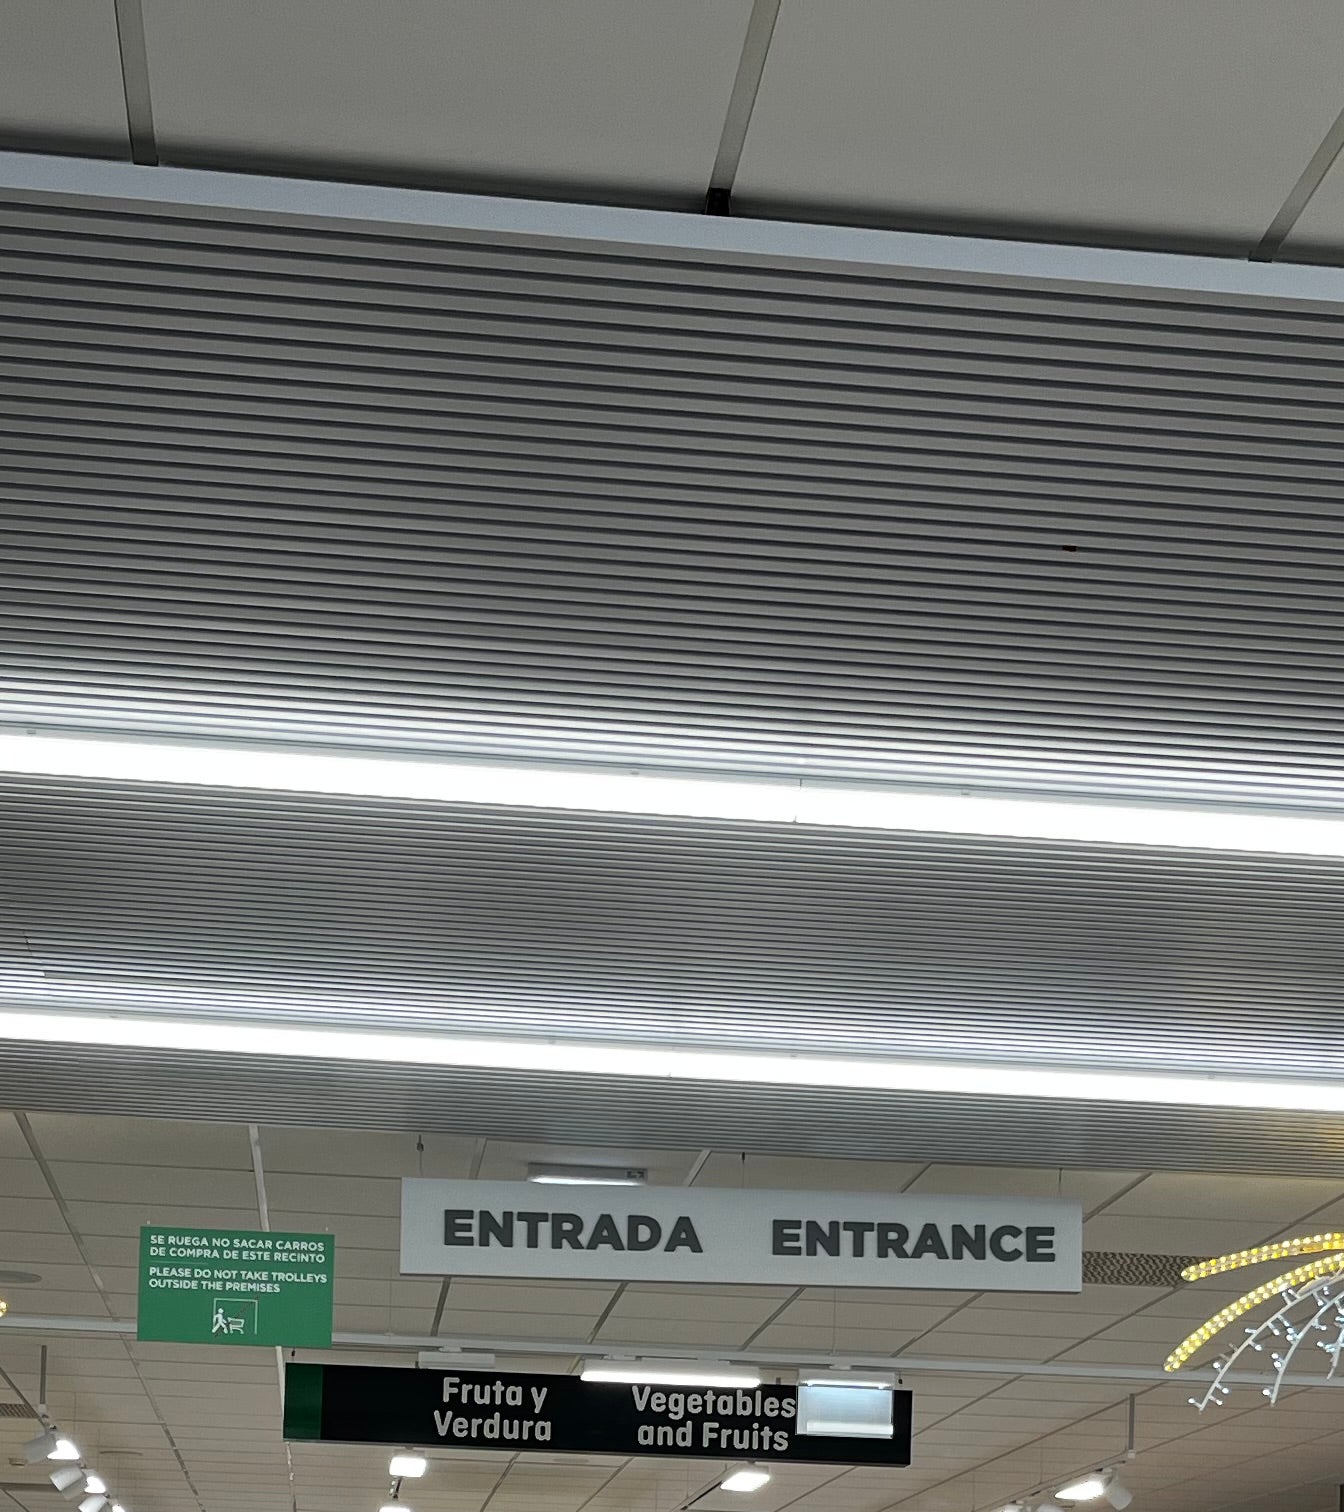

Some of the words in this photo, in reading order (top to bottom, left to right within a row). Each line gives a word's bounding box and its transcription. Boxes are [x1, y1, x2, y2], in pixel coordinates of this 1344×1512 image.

[150, 1235, 164, 1245] SE
[167, 1236, 208, 1247] RUEGA
[212, 1237, 230, 1248] NO
[233, 1238, 272, 1250] SACAR
[276, 1240, 325, 1252] CARROS
[443, 1209, 703, 1253] ENTRADA
[771, 1219, 1056, 1263] ENTRANCE
[149, 1247, 165, 1257] DE
[169, 1248, 220, 1259] COMPRA
[223, 1250, 239, 1260] DE
[242, 1251, 270, 1261] ESTE
[273, 1252, 325, 1263] RECINTO
[149, 1267, 191, 1278] PLEASE
[194, 1269, 211, 1279] DO
[214, 1270, 238, 1280] NOT
[240, 1271, 268, 1281] TAKE
[271, 1272, 327, 1283] TROLLEYS
[149, 1279, 198, 1290] OUTSIDE
[201, 1281, 223, 1291] THE
[225, 1282, 280, 1293] PREMISES
[442, 1376, 522, 1406] Fruta
[529, 1386, 548, 1413] y
[631, 1385, 796, 1420] Vegetables
[433, 1410, 552, 1441] Verdura
[637, 1419, 693, 1448] and
[701, 1422, 789, 1452] Fruits
